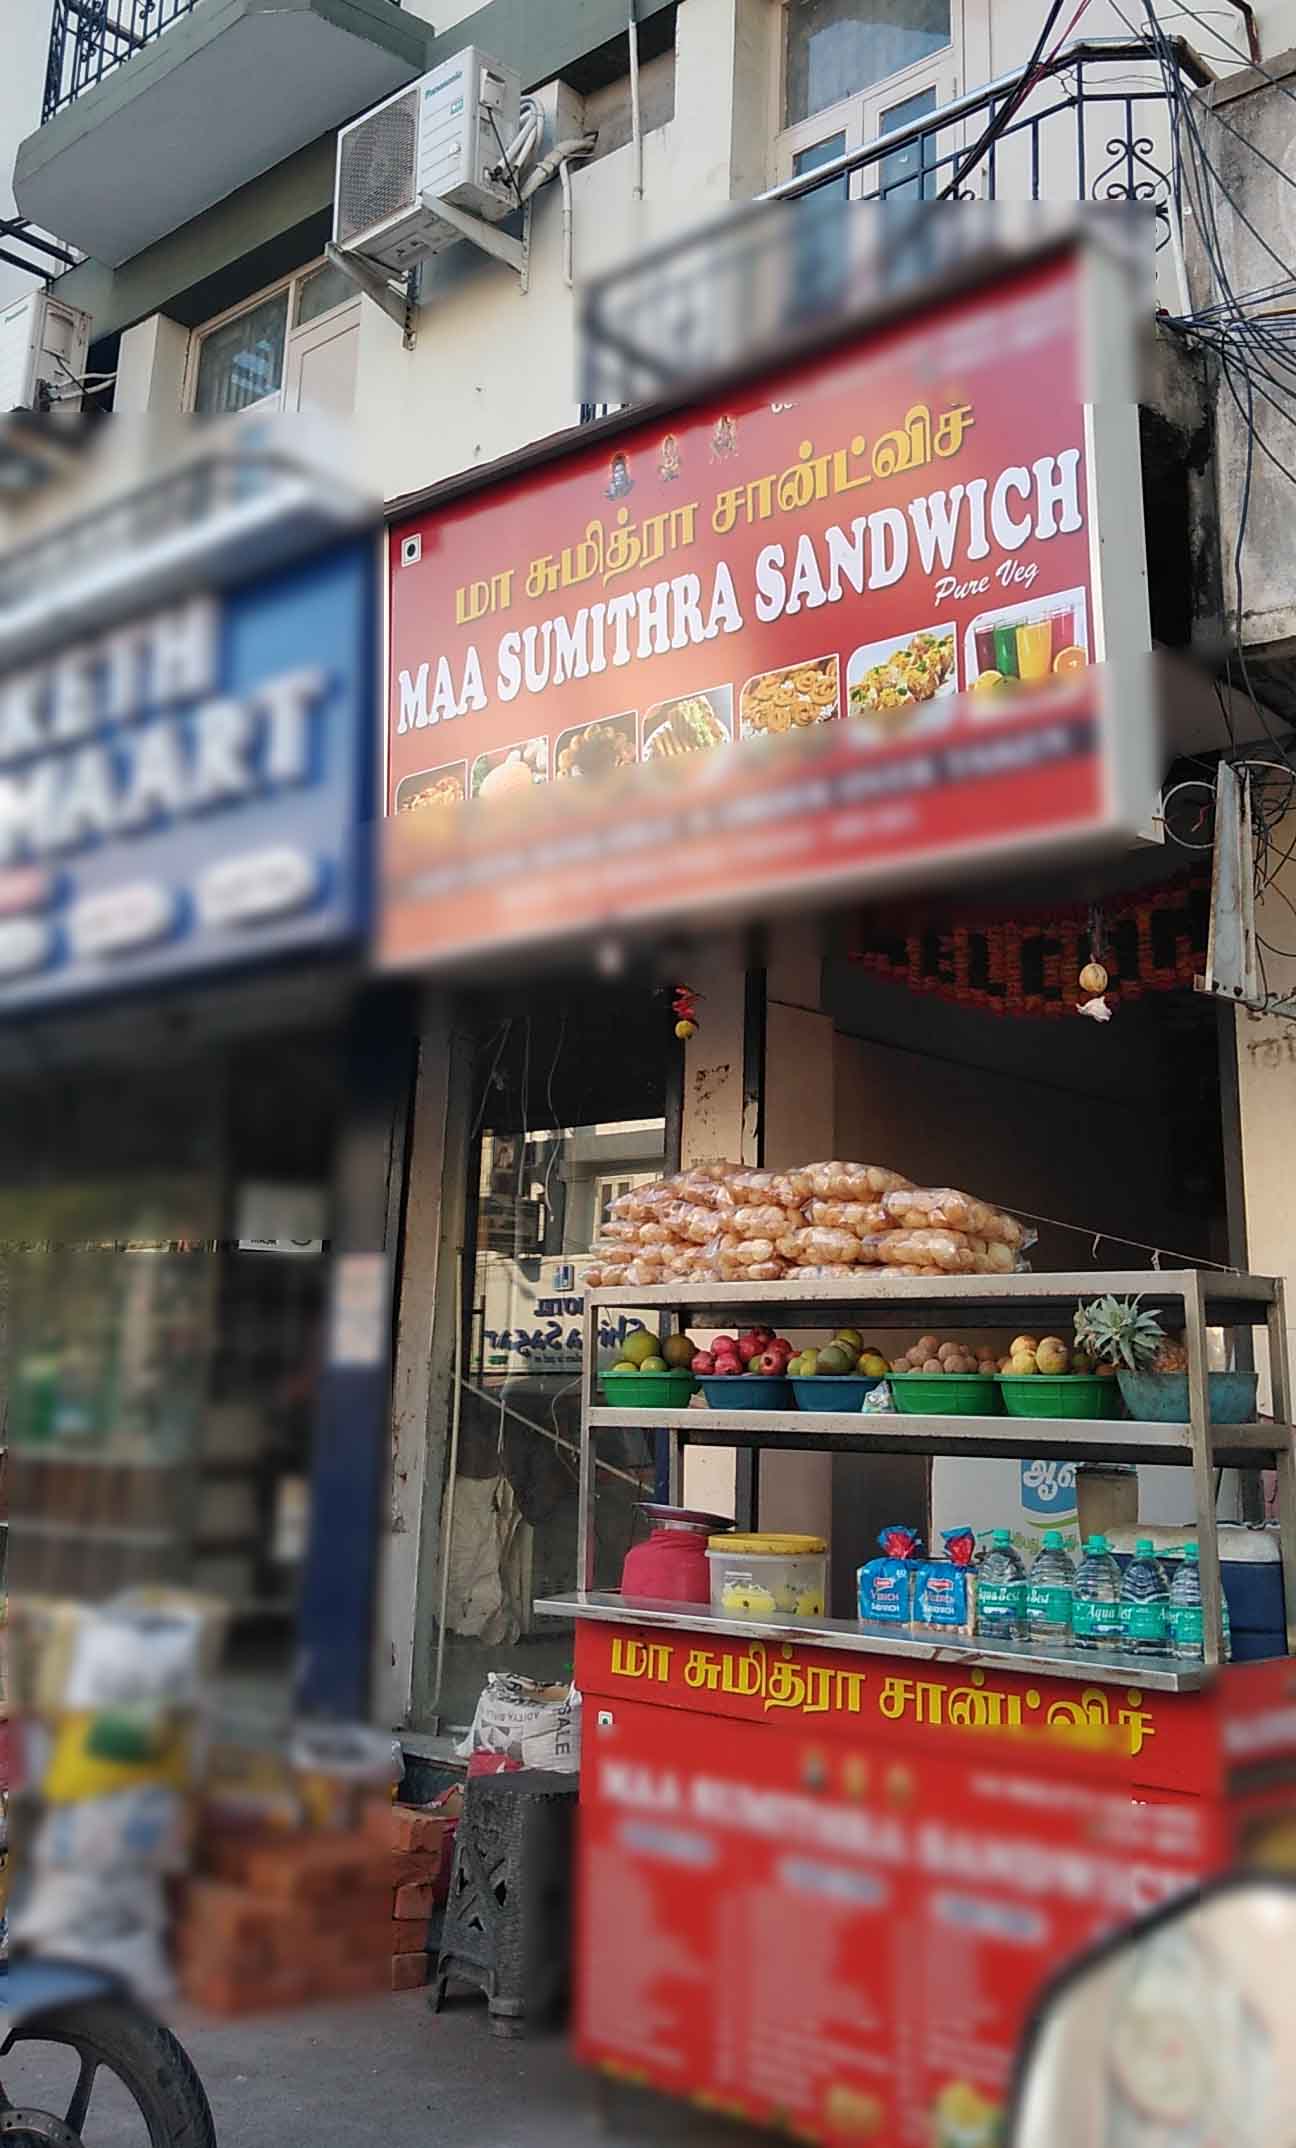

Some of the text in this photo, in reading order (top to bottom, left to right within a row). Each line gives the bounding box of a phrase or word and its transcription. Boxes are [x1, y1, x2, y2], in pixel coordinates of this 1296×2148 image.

[396, 447, 1084, 735] MAA SUMITHRA SANDWICH
[456, 549, 515, 625] மா
[526, 502, 699, 588] சுமித்ரா
[934, 560, 1039, 606] Pure Veg
[610, 1637, 673, 1682] மா
[684, 1639, 866, 1714] சுமித்ரா
